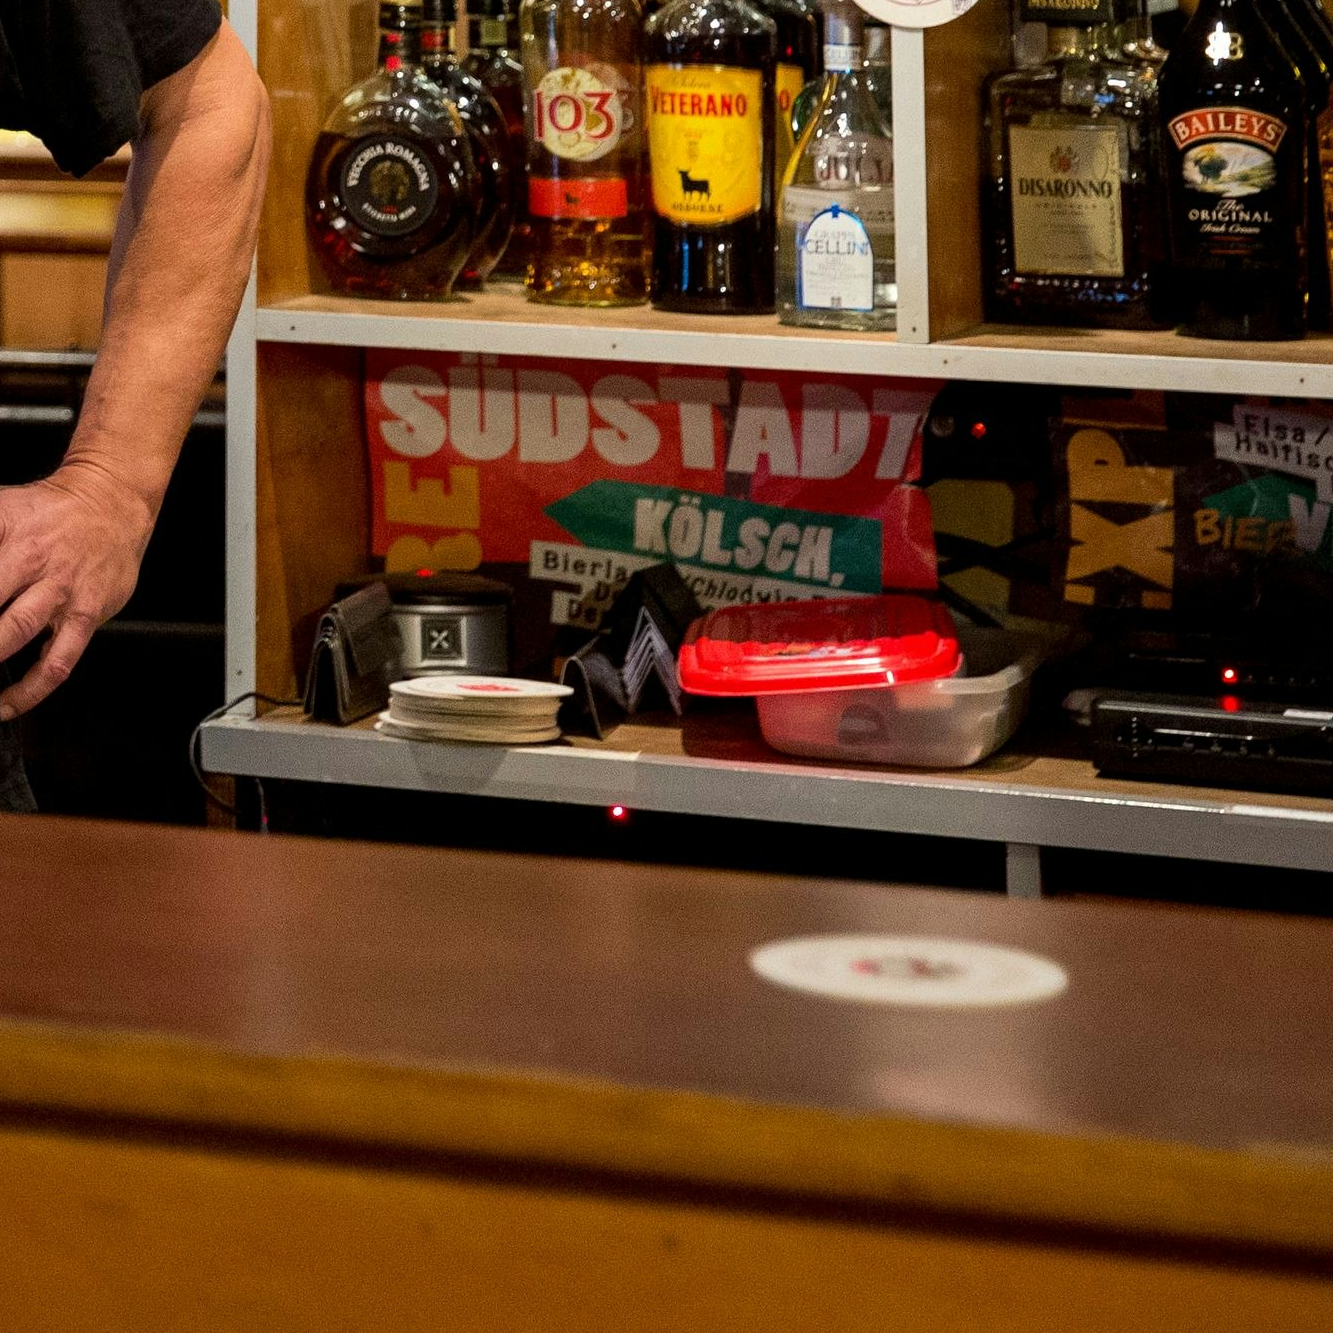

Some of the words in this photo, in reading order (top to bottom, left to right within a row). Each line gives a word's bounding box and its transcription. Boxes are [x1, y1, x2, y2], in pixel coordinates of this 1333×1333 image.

[533, 89, 616, 144] 103
[650, 84, 748, 117] VETERANO
[1174, 112, 1280, 142] BAILEYS
[1018, 177, 1113, 199] DISARONNO
[1188, 209, 1273, 223] ORIGINAL
[378, 354, 936, 482] SÜDSTADT
[1243, 413, 1306, 444] Elsa
[633, 495, 849, 589] KÖLSCH,
